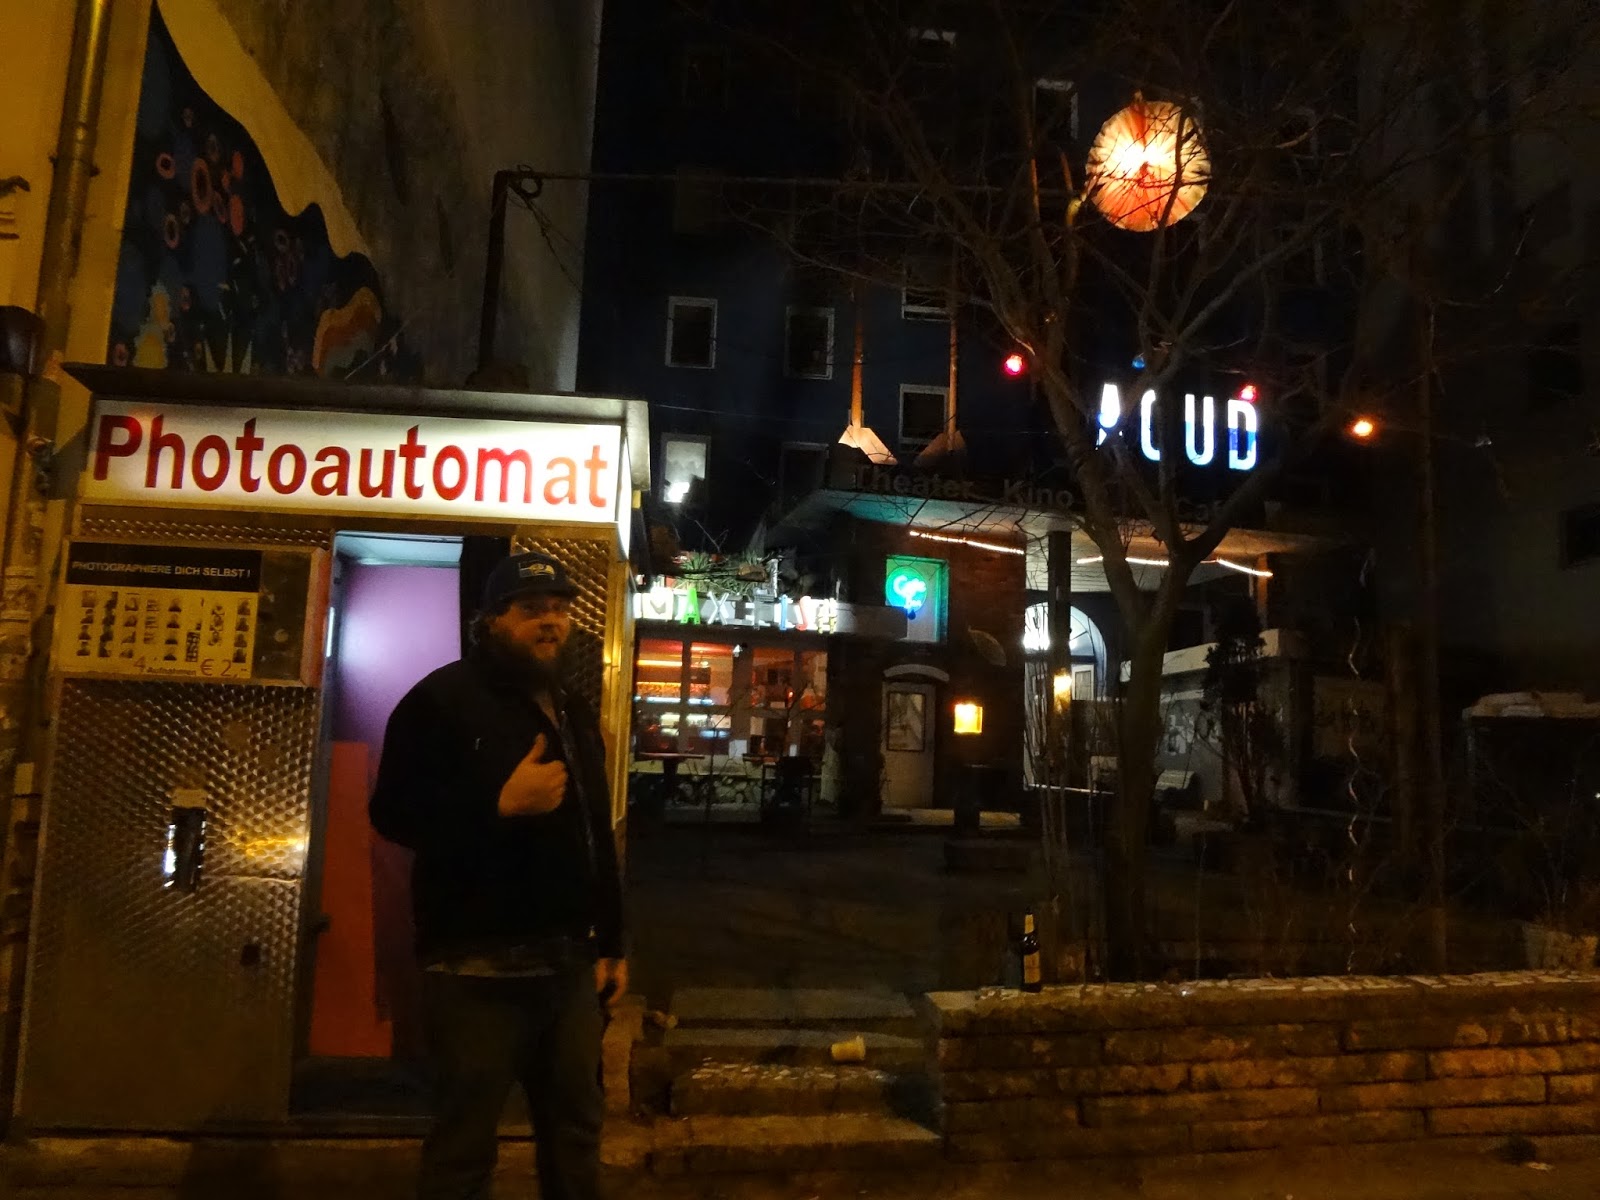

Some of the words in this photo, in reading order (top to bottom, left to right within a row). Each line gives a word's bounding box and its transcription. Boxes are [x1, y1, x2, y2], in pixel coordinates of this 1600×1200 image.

[92, 414, 609, 509] Photoautomat
[855, 464, 978, 498] Theater
[1003, 477, 1074, 509] Kino
[71, 561, 172, 575] PHOTOGRAPHIERE
[174, 564, 200, 577] DICH
[202, 566, 244, 578] SELBST
[132, 655, 146, 672] 4
